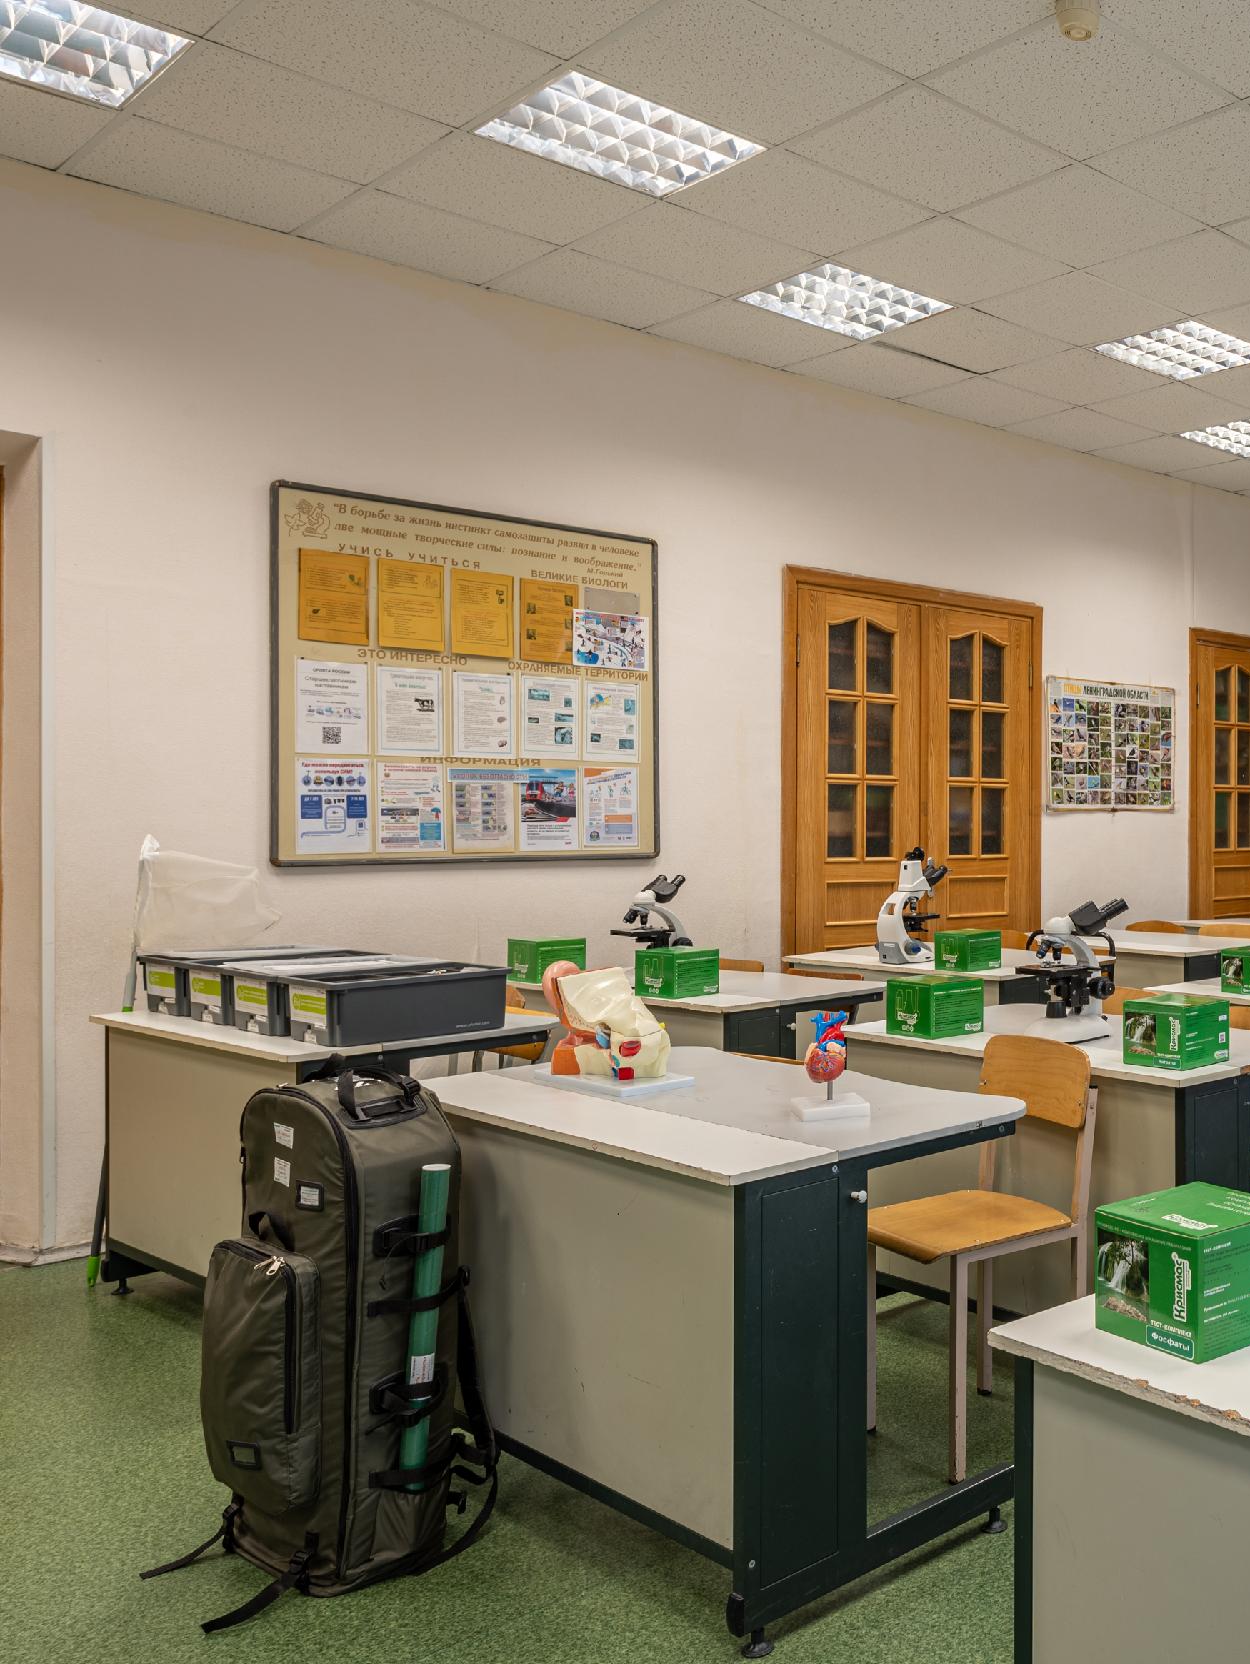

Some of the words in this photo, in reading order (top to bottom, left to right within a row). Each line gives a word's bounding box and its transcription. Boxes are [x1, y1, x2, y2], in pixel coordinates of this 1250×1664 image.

[333, 522, 355, 533] две
[360, 526, 408, 540] мощные
[414, 532, 474, 550] творческие
[477, 542, 505, 553] силы:
[511, 548, 557, 561] познание
[561, 554, 568, 562] и
[350, 505, 391, 521] борьбе
[393, 513, 406, 523] за
[408, 517, 442, 529] жизнь
[445, 520, 491, 536] инстинкт
[599, 544, 640, 559] человеке
[338, 543, 394, 558] УЧИСЬ
[408, 552, 481, 570] УЧИТЬСЯ
[530, 568, 578, 583] ВЕЛИКИЕ
[581, 576, 629, 590] БИОЛОГИ
[357, 649, 386, 660] ЭТО
[390, 652, 468, 666] ИНТЕРЕСНО
[508, 661, 582, 676] ОХРАНЯЕМЫЕ
[584, 669, 649, 682] ТЕРРИТОРИИ
[1083, 685, 1126, 699] ЛЕНИНГРАДСКОЙ
[1127, 688, 1149, 700] ОБЛАСТИ
[419, 756, 542, 767] ИНФОРМАЦИЯ
[1173, 1258, 1187, 1321] Крисмас
[1151, 1332, 1190, 1352] Фосфаты
